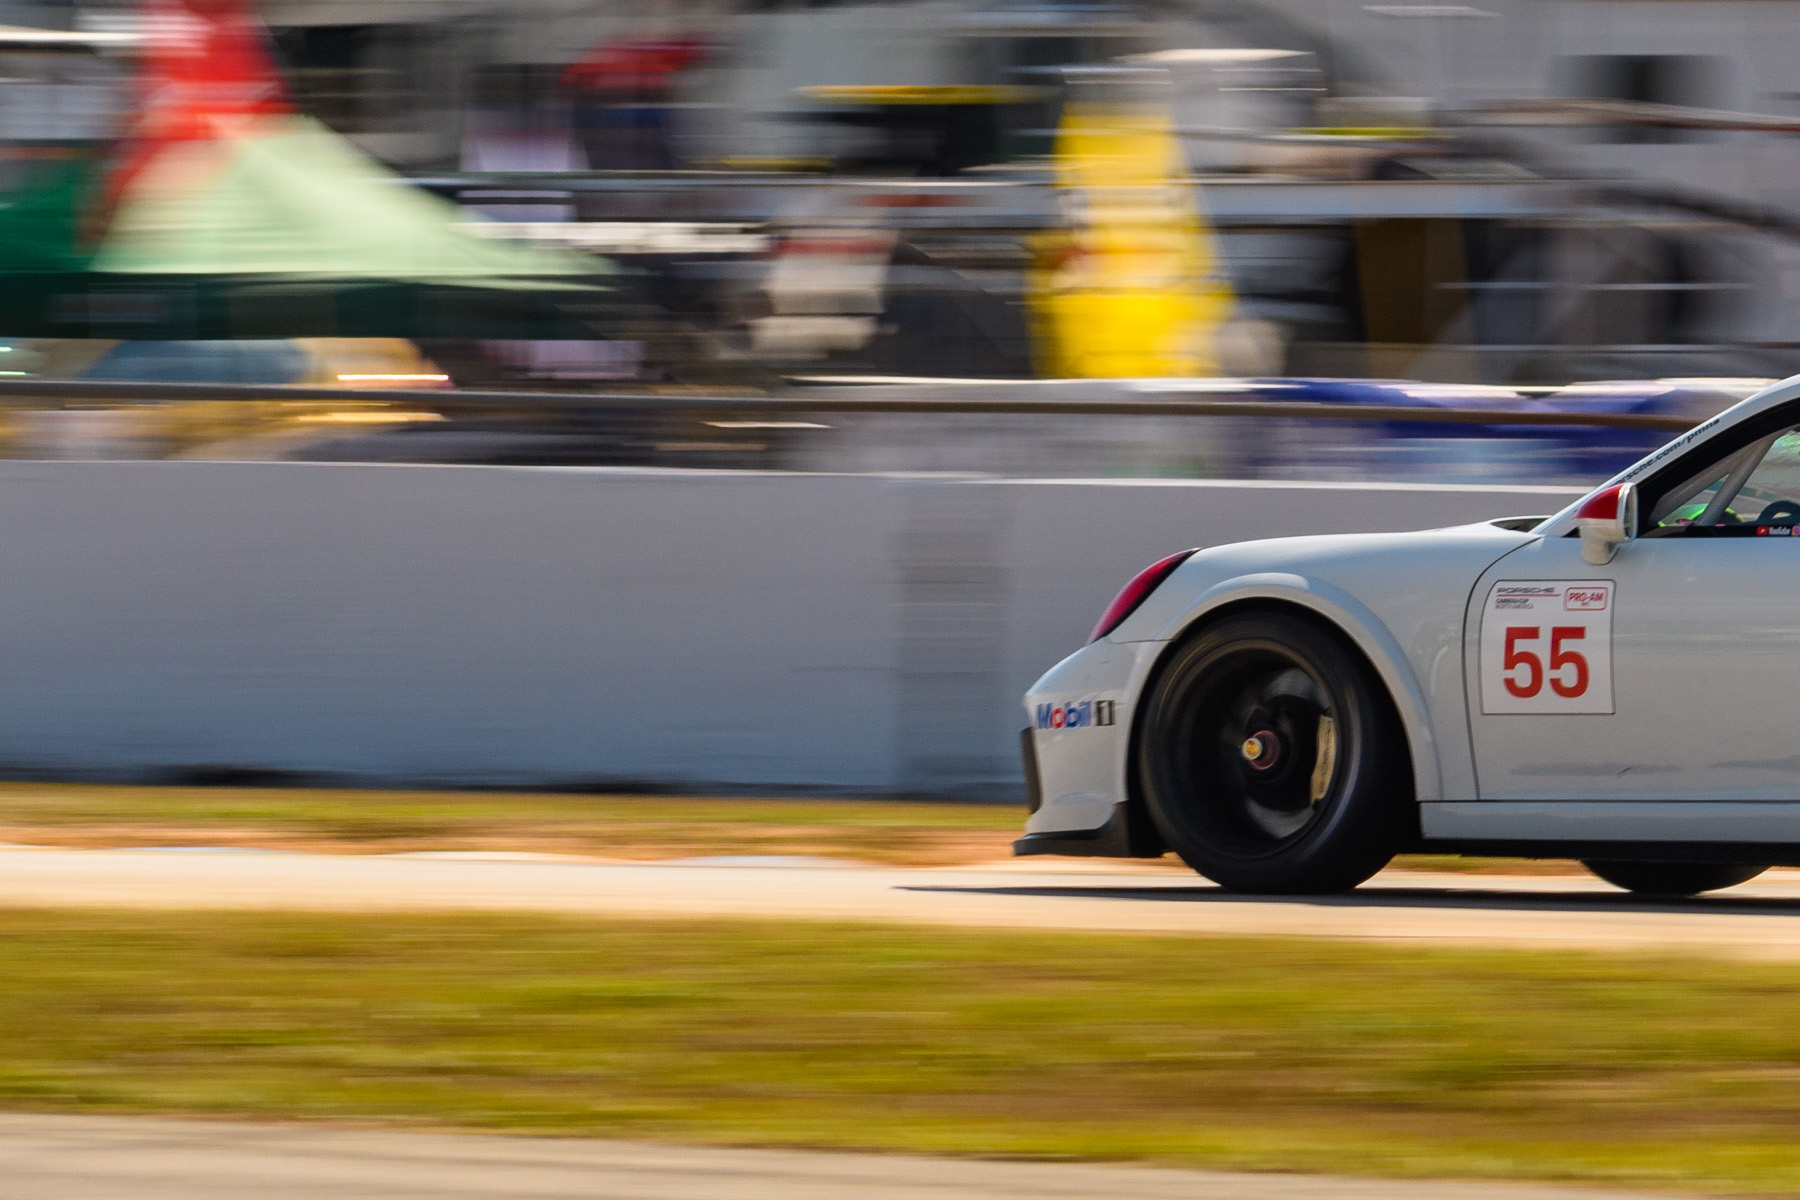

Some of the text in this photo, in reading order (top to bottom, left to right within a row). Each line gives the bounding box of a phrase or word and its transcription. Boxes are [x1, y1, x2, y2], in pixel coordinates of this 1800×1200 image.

[1568, 592, 1604, 602] PRO-AM
[1503, 626, 1590, 699] 55
[1036, 700, 1092, 730] Mobil
